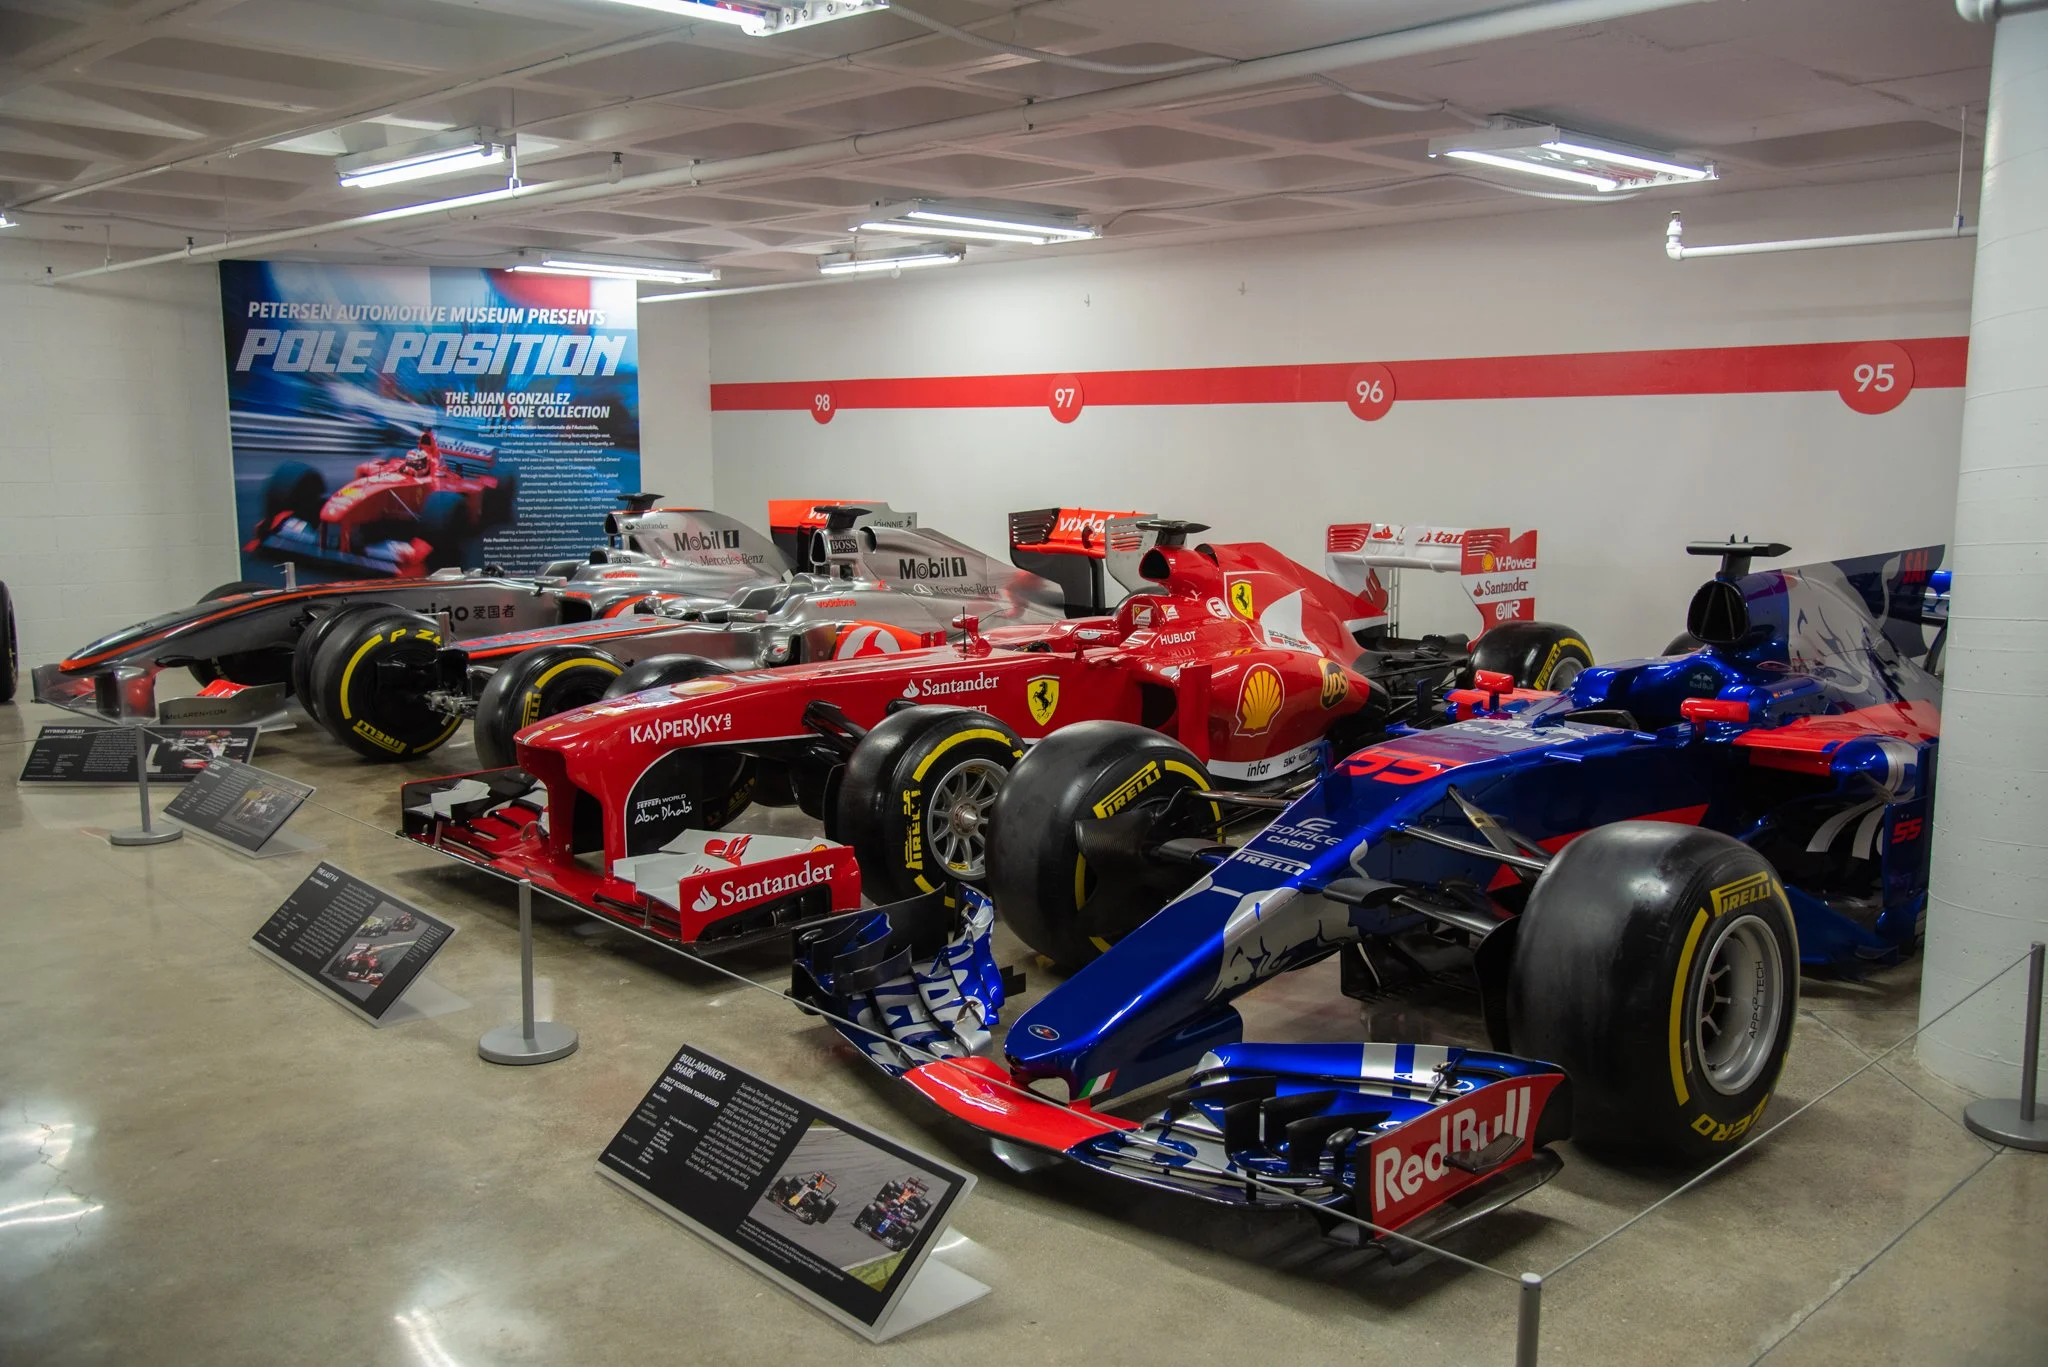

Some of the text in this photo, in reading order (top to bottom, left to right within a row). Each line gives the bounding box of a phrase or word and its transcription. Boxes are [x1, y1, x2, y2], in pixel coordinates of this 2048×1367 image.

[248, 302, 607, 325] PETERSEN AUTOMOTIVE MUSEUM PRESENTS
[235, 329, 627, 376] POLE POSITION
[1853, 363, 1895, 392] 95
[445, 392, 571, 405] THE JUAN GONZALEZ
[1054, 387, 1075, 408] 97
[1356, 380, 1384, 403] 96
[445, 406, 611, 418] FORMULA ONE COLLECTION
[815, 394, 830, 412] 98
[635, 522, 669, 530] Santander
[874, 520, 904, 528] JOHNNIE
[673, 531, 720, 552] Mobil
[831, 540, 857, 551] BOSS
[700, 553, 764, 567] Mercedes-Benz
[900, 558, 950, 580] Mobil
[1496, 556, 1536, 571] V-Power
[1485, 576, 1528, 596] Santander
[473, 604, 516, 619] 爱国者
[1160, 631, 1196, 646] HUBLOT
[922, 672, 1000, 696] Santander
[352, 720, 407, 754] PIRELLI
[630, 713, 723, 744] KASPERSKY
[1247, 761, 1270, 778] infor
[662, 794, 686, 804] WORLD
[1092, 760, 1161, 819] PIRELLI
[634, 800, 692, 824] Abu Dhabi
[1267, 824, 1342, 846] EDIFICE
[1892, 817, 1922, 844] 55
[1266, 835, 1316, 850] CASIO
[720, 860, 834, 906] Santander
[1710, 871, 1770, 918] PIRELLI
[671, 1062, 696, 1079] SHARK
[678, 1053, 728, 1082] BULL-MONKEY-
[663, 1075, 720, 1107] 2017 SCUDERIA TORO ROSSO
[1690, 1092, 1770, 1141] ZERO
[1375, 1086, 1531, 1212] Red Bull
